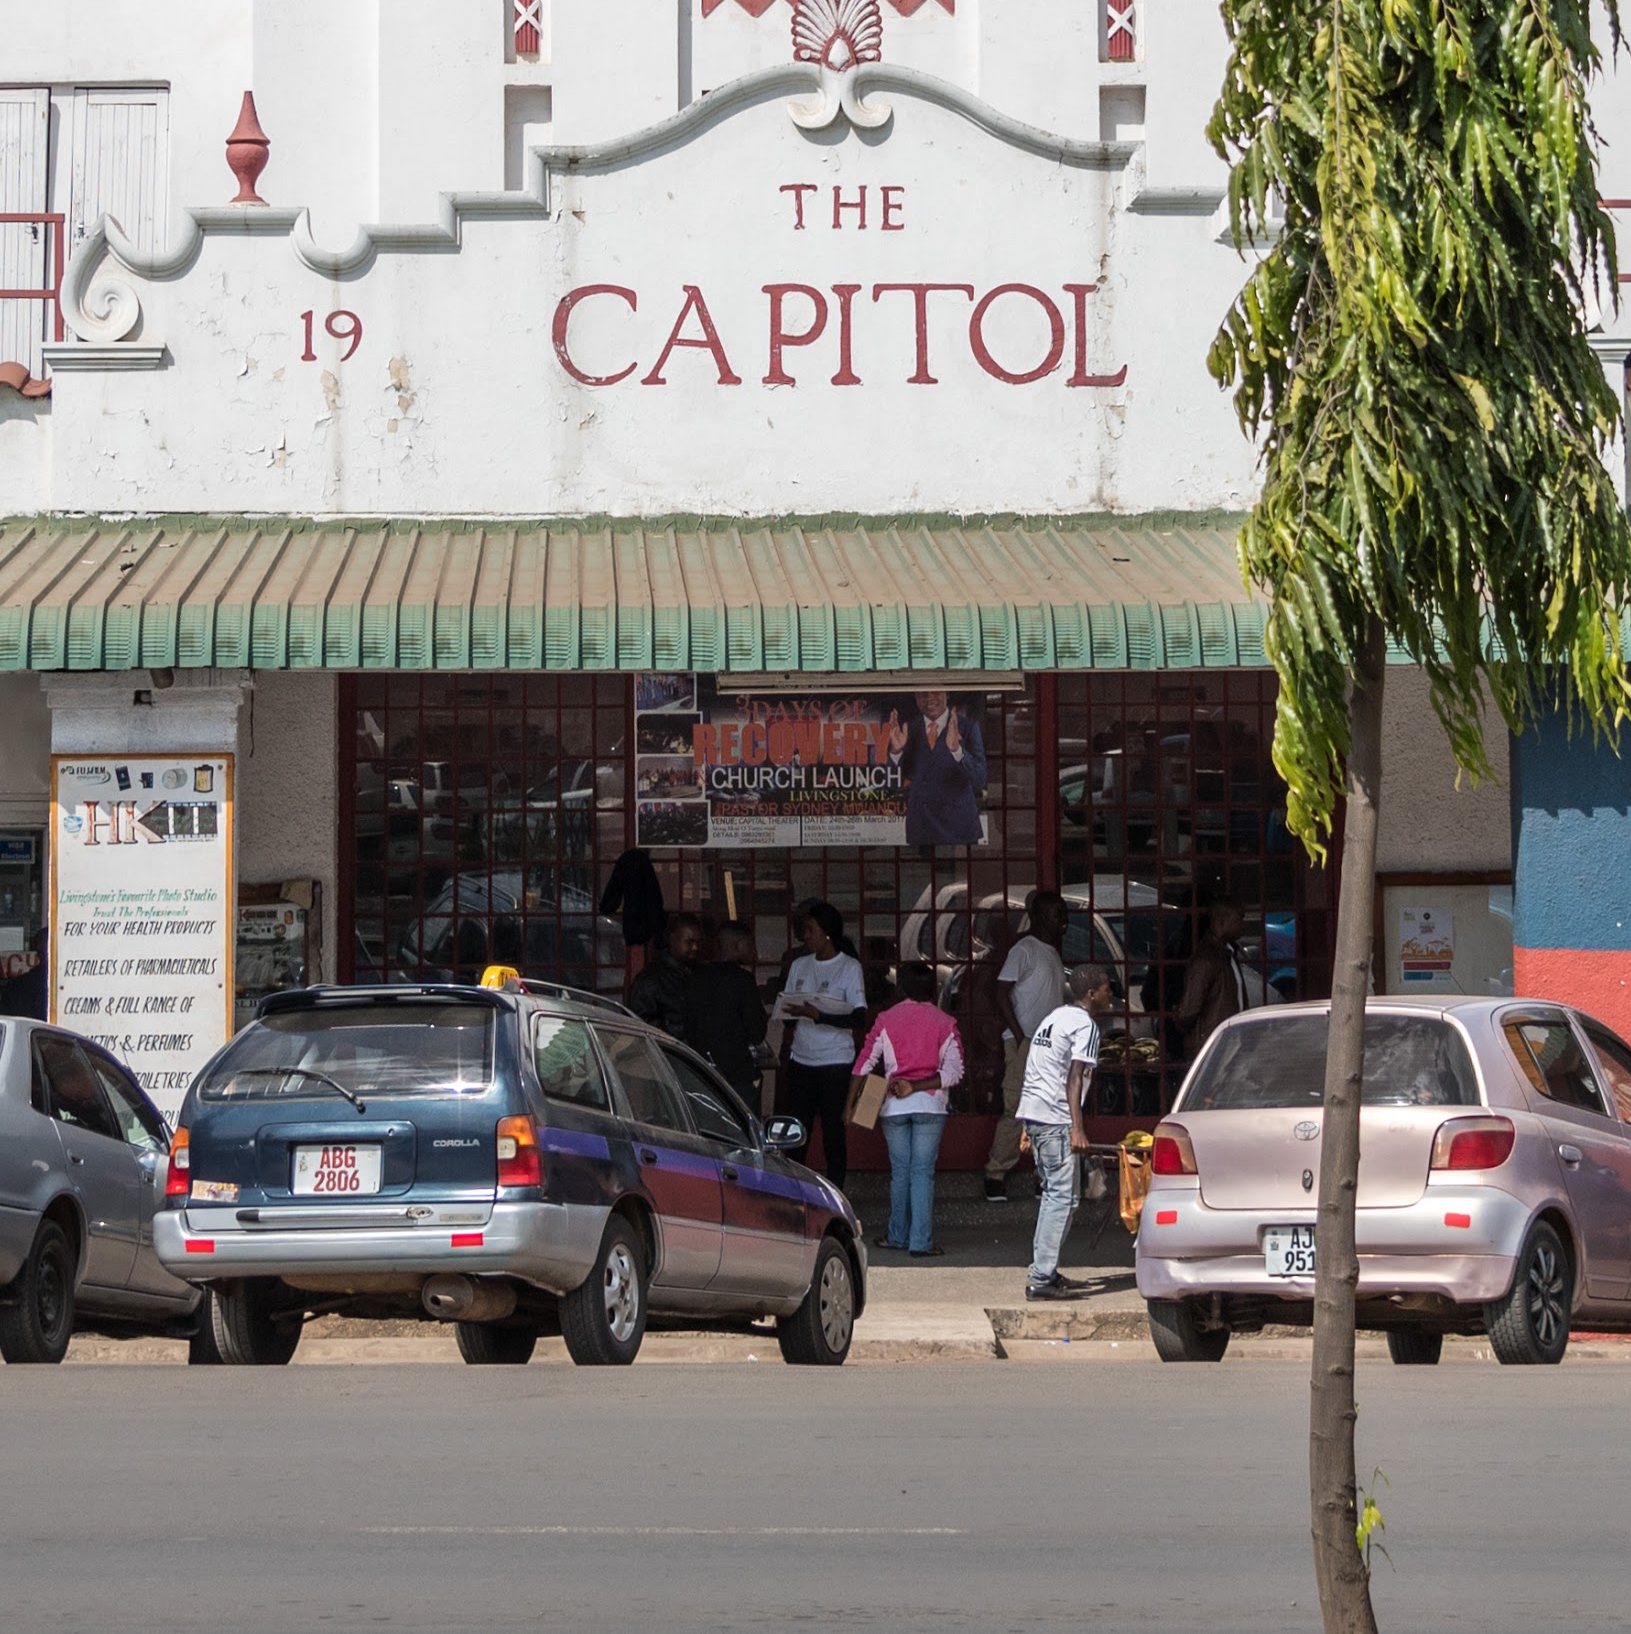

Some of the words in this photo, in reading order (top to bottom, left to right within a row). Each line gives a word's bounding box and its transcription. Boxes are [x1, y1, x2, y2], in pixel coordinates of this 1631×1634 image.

[779, 184, 906, 231] THE
[299, 309, 364, 362] 19
[551, 283, 1128, 387] CAPITOL
[829, 700, 867, 722] OF
[693, 723, 891, 766] RECOVERY
[711, 766, 805, 789] CHURCH
[813, 766, 902, 788] LAUNCH
[790, 790, 889, 801] LIVINGSTONE
[722, 802, 779, 815] PASTOR
[782, 802, 840, 815] SYDNEY
[83, 800, 167, 846] HK
[769, 817, 799, 825] THEATER
[157, 888, 181, 902] Photo
[183, 888, 217, 902] Studio
[93, 907, 116, 918] Trust
[118, 906, 134, 917] The
[135, 906, 188, 919] Professionals
[64, 922, 87, 937] FOR
[90, 921, 121, 936] YOUR
[123, 921, 163, 935] HEALTH
[163, 920, 217, 935] PRODUCTS
[64, 959, 118, 977] RETAILERS
[120, 959, 135, 976] OF
[64, 996, 102, 1015] CREAMS
[105, 997, 114, 1016] &
[115, 996, 139, 1014] FULL
[142, 996, 178, 1014] RANGE
[180, 996, 195, 1013] OF
[123, 1035, 135, 1053] &
[137, 1034, 194, 1051] PERFUMES
[433, 1139, 480, 1147] COROLLA
[320, 1147, 356, 1169] ABG
[314, 1170, 360, 1192] 2806
[1290, 1228, 1316, 1248] AJ
